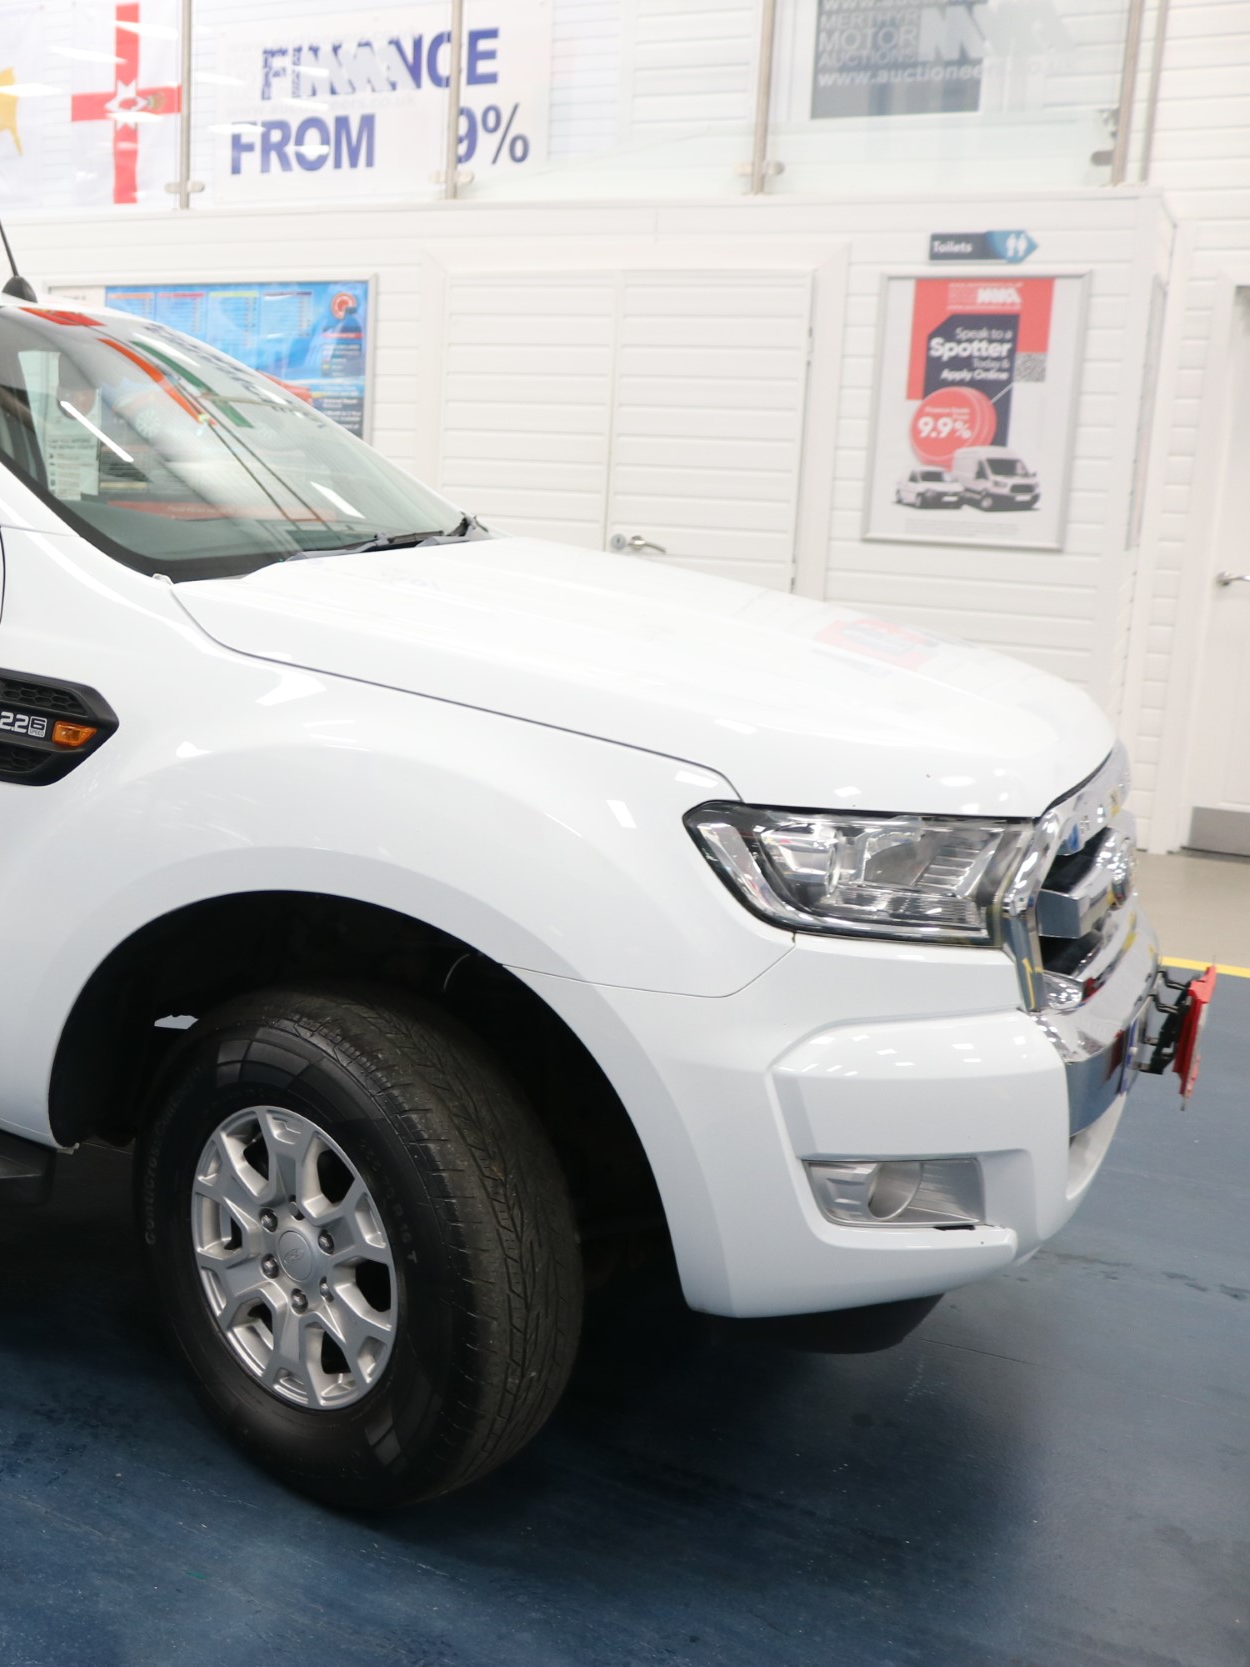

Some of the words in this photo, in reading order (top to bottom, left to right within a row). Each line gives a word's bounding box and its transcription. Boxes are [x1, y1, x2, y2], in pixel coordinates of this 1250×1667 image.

[820, 9, 918, 29] MERTHYR
[819, 26, 917, 51] MOTOR
[818, 48, 916, 67] AUCTIONS
[231, 112, 375, 175] FROM
[932, 241, 973, 254] Toilets
[956, 327, 988, 341] Speak
[992, 328, 1003, 339] to
[1005, 330, 1013, 339] a
[930, 337, 1012, 361] Spotter
[972, 358, 1000, 371] Today
[940, 369, 972, 381] Apply
[974, 369, 1009, 380] Online
[917, 416, 972, 439] 9.9%
[0, 711, 29, 733] 2.2
